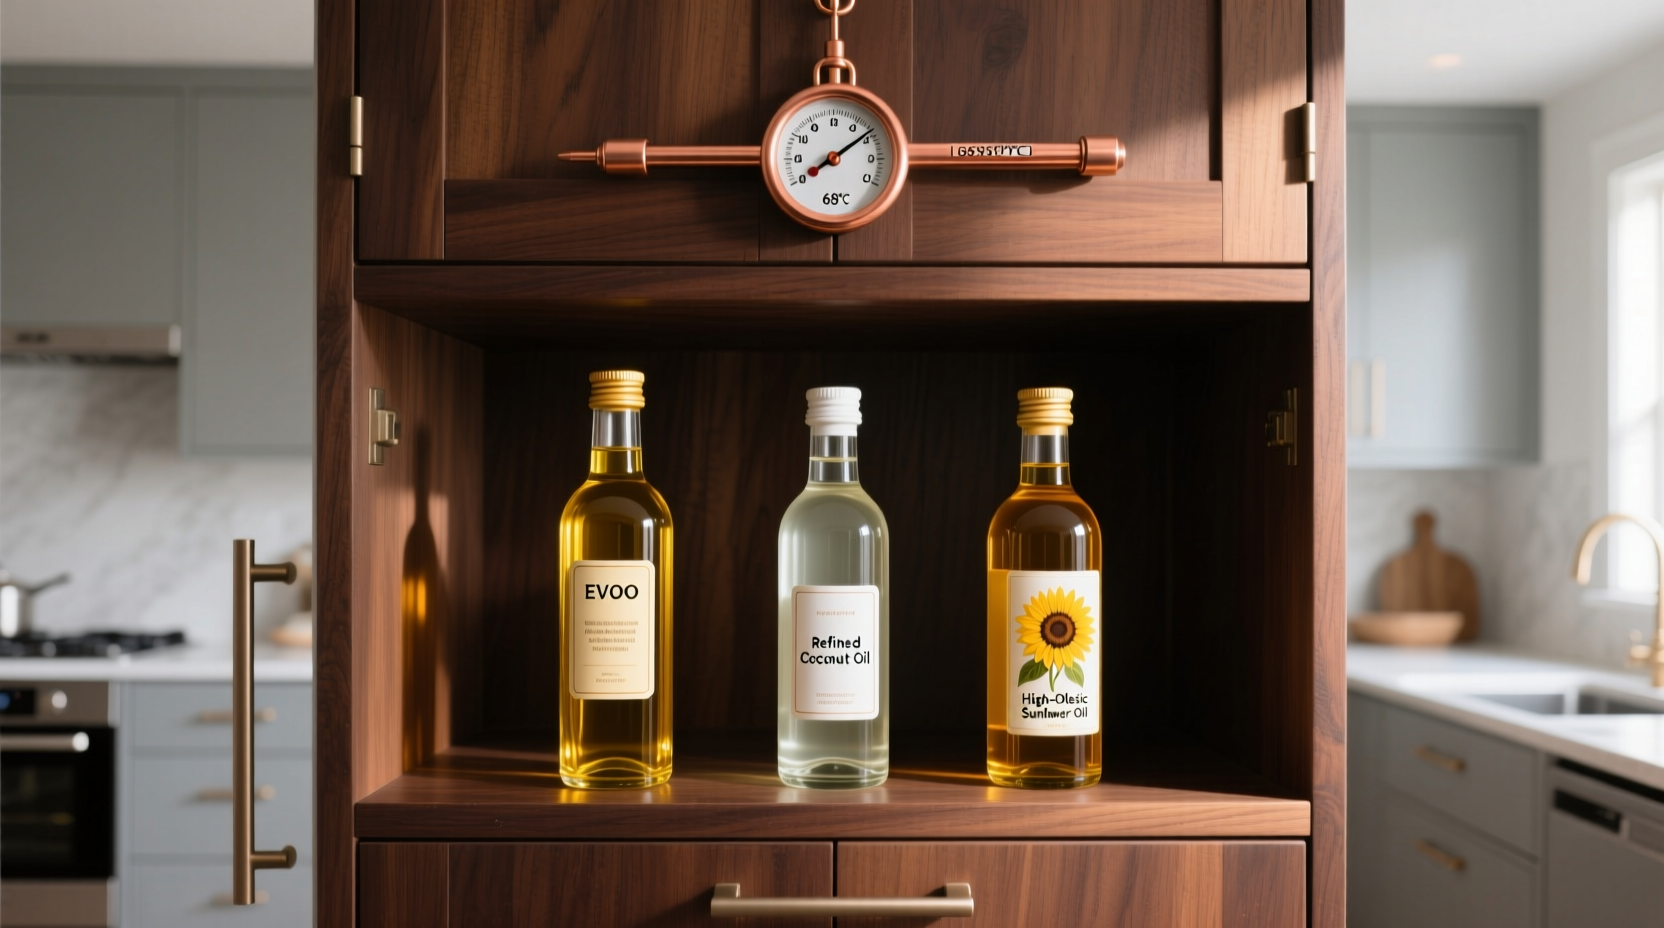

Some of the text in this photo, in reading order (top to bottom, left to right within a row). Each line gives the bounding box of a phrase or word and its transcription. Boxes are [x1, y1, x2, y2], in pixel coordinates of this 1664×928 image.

[584, 583, 639, 600] EVOO
[811, 636, 861, 649] Refined
[853, 651, 870, 664] Oil
